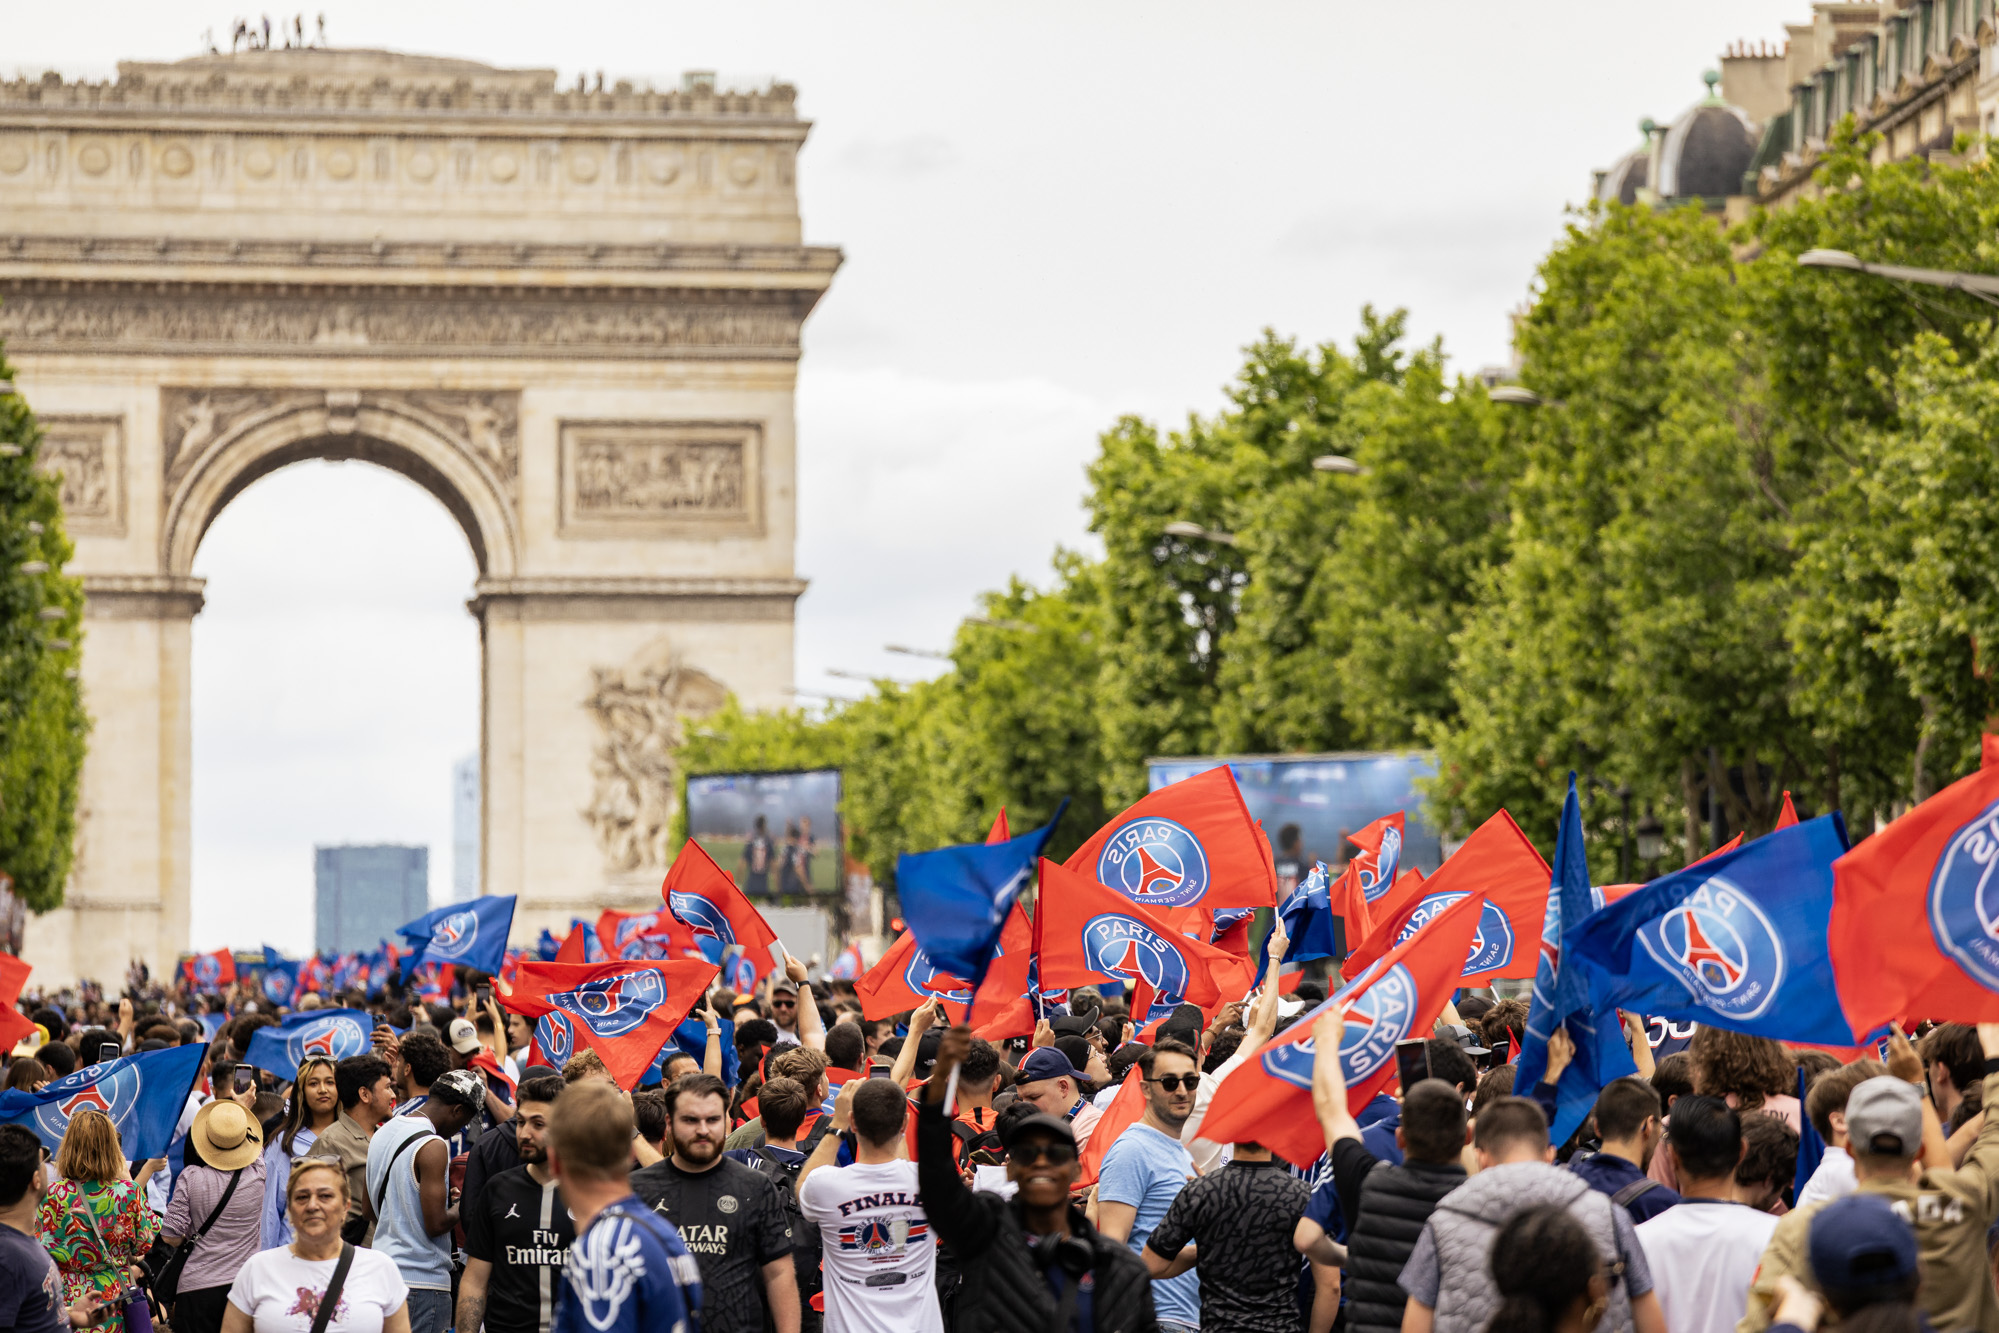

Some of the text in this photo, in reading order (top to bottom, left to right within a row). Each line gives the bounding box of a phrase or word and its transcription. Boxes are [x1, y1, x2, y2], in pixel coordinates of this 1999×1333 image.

[1096, 921, 1169, 953] PARIS
[1348, 974, 1406, 1074] PARIS
[533, 1230, 559, 1247] Fly
[676, 1225, 728, 1243] ATAR
[505, 1245, 572, 1265] Emirat
[684, 1242, 727, 1256] RWAYS
